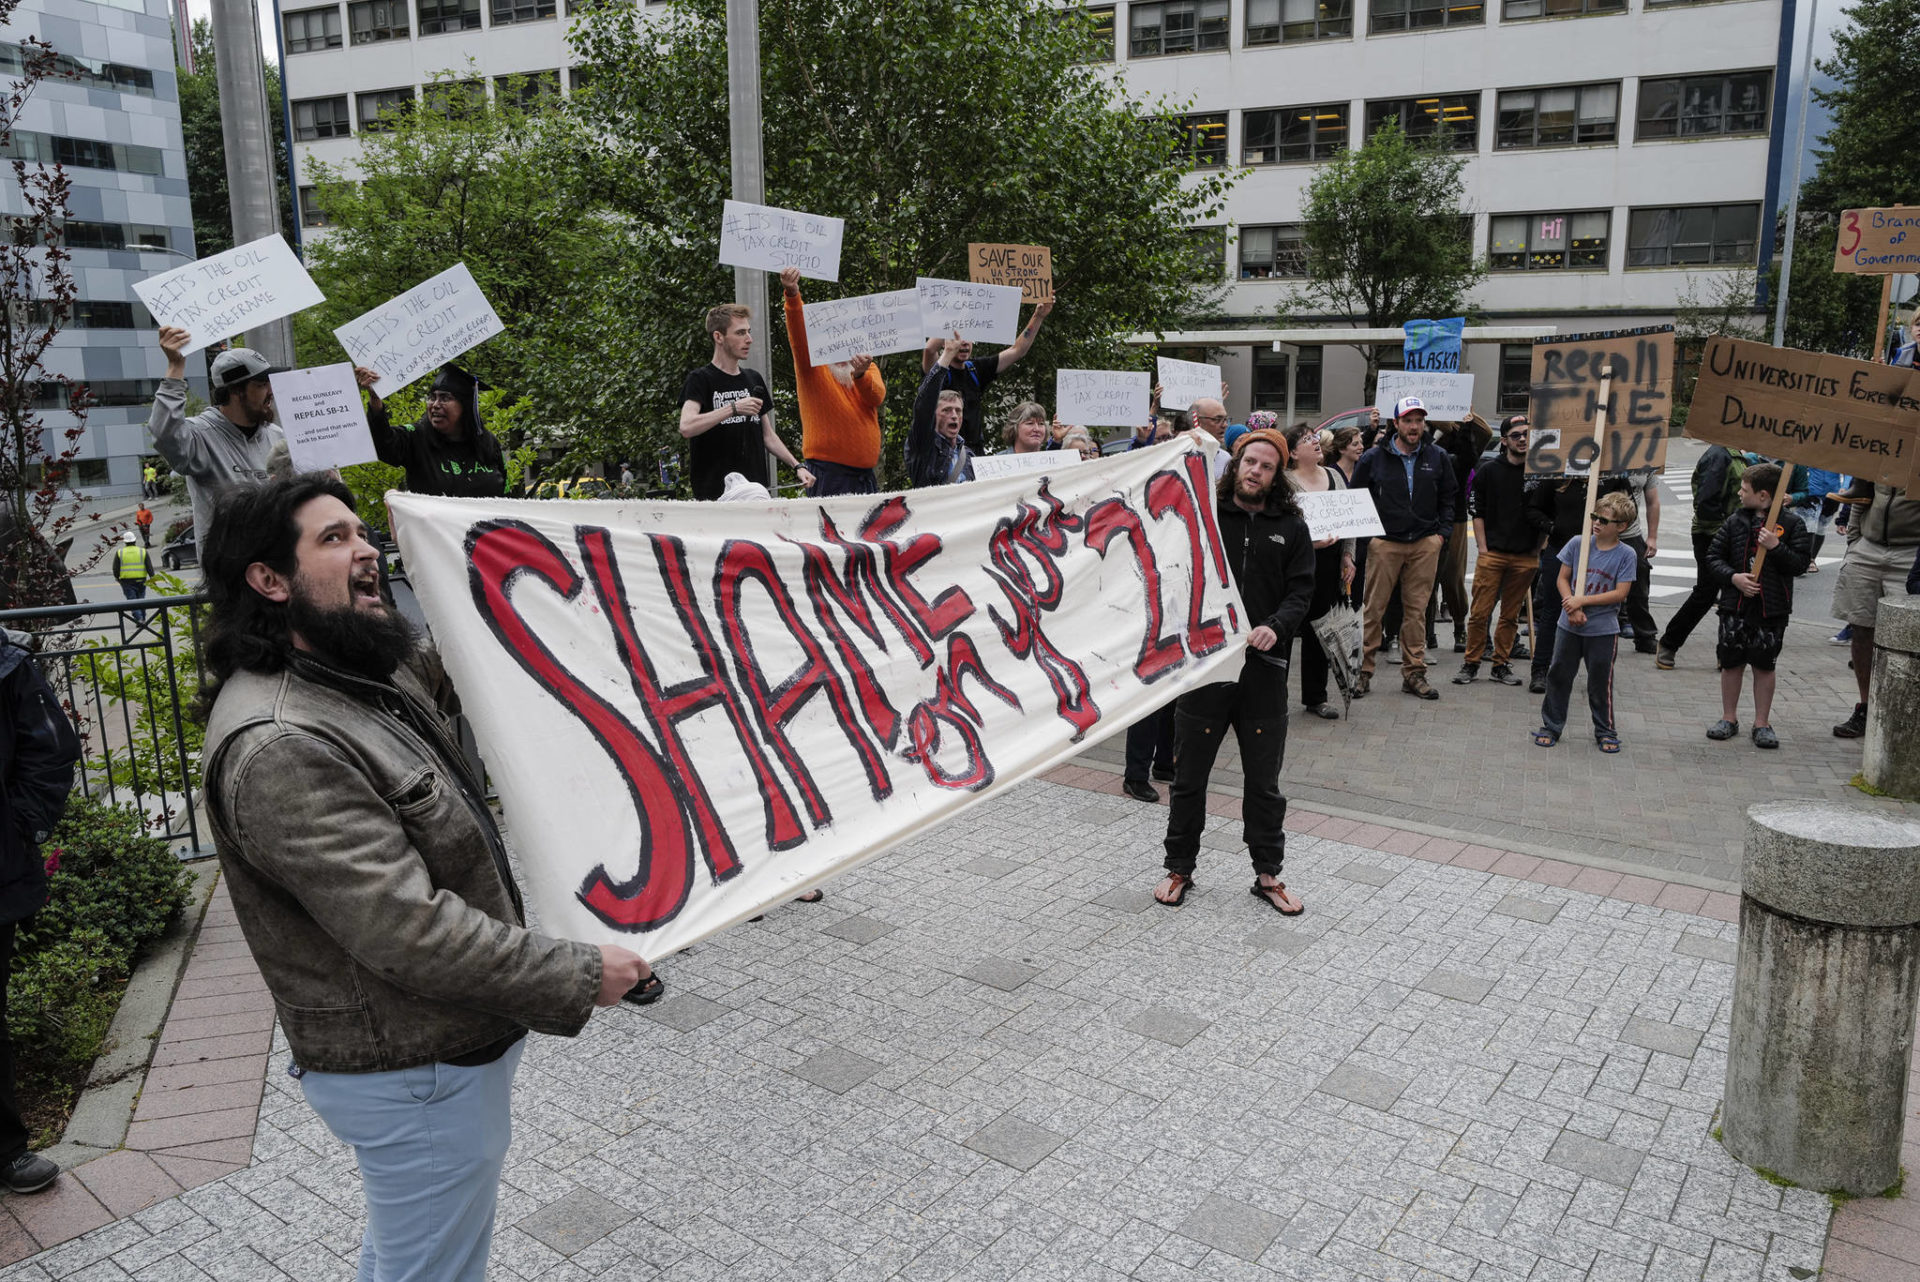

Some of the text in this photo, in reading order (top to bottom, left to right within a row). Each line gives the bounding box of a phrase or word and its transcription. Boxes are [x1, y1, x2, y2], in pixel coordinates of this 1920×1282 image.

[780, 216, 799, 233] THE
[804, 222, 828, 237] OIL
[1840, 211, 1862, 256] 3
[737, 235, 813, 252] TAX CREDIT
[1889, 231, 1907, 244] of
[198, 262, 233, 281] THE
[235, 250, 269, 268] OIL
[769, 250, 821, 269] STUPID
[978, 247, 1044, 269] SAVE OUR
[991, 268, 1039, 278] UA STRONG
[171, 274, 264, 328] TAX CREDIT
[401, 294, 431, 317] THE
[433, 281, 460, 301] OIL
[953, 286, 973, 297] THE
[977, 288, 996, 299] OIL
[855, 299, 877, 312] THE
[882, 296, 907, 308] OIL
[930, 301, 993, 311] TAX CREDIT
[203, 291, 276, 338] #REFRAME
[823, 312, 897, 339] TAX CREDIT
[372, 304, 458, 376] TAX CREDIT
[1406, 351, 1458, 370] ALASKA
[1710, 343, 1840, 397] UNIVERSITIES
[1104, 374, 1120, 386] THE
[1125, 376, 1144, 387] OIL
[291, 394, 312, 403] RECALL
[1071, 391, 1132, 404] TAX CREDIT
[294, 404, 350, 421] REPEAL SB-21
[1530, 387, 1666, 430] THE
[1720, 395, 1823, 444] DUNLEAVY
[1039, 455, 1056, 466] OIL
[1527, 427, 1662, 474] GOV!
[1339, 494, 1362, 506] OIL
[465, 495, 977, 934] SHAME
